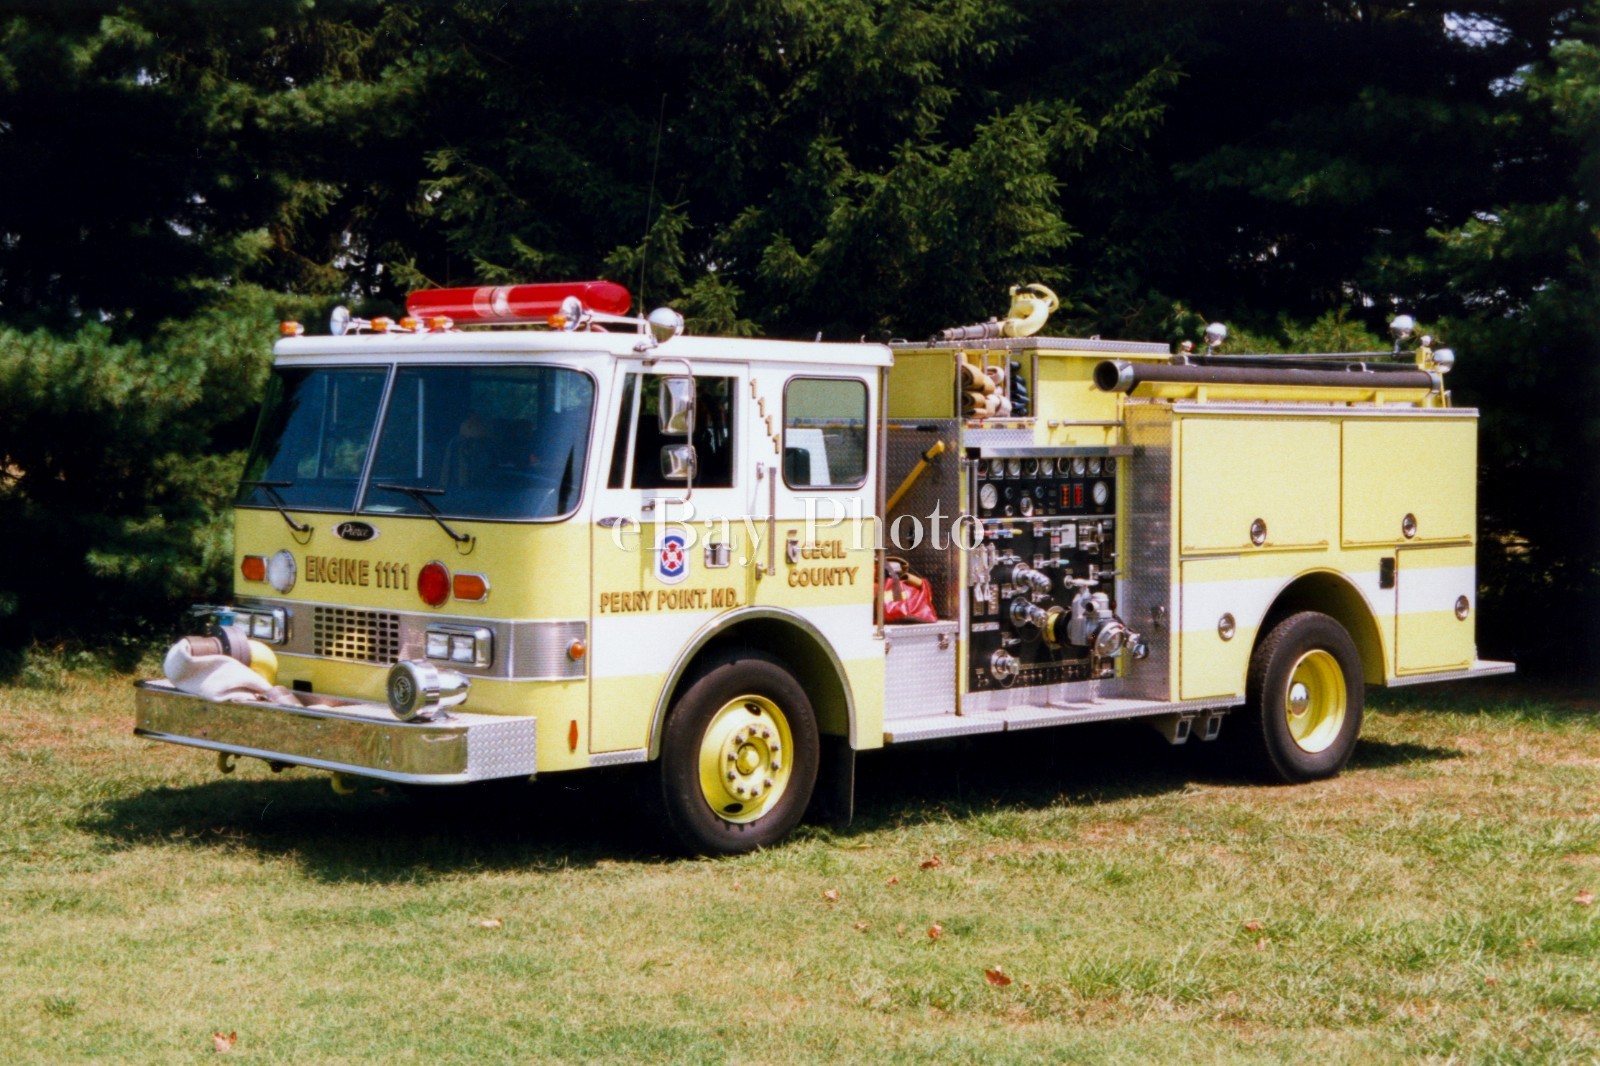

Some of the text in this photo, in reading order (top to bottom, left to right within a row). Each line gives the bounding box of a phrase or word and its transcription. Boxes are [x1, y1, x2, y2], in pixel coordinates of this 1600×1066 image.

[801, 540, 847, 559] CECIL
[305, 555, 409, 591] ENGINE 1111
[787, 566, 859, 588] COUNTY
[600, 587, 740, 613] PERRY POINT, MD.
